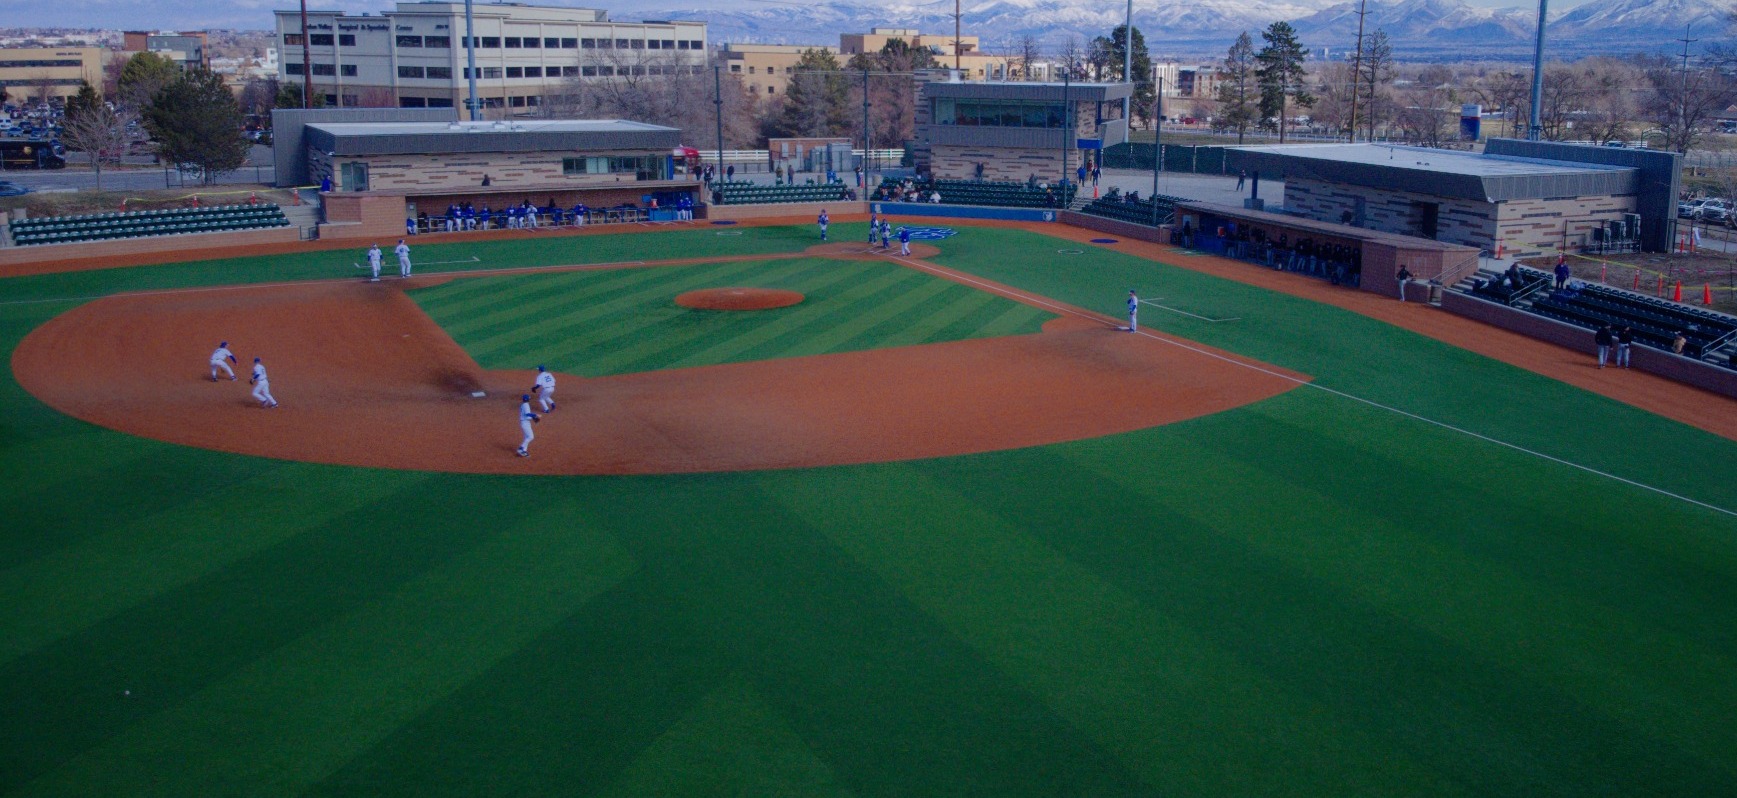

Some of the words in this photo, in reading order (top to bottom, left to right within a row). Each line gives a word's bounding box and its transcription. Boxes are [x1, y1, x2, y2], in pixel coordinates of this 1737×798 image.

[317, 23, 333, 31] Valley
[338, 23, 358, 32] Surgical
[367, 24, 390, 32] Specialty
